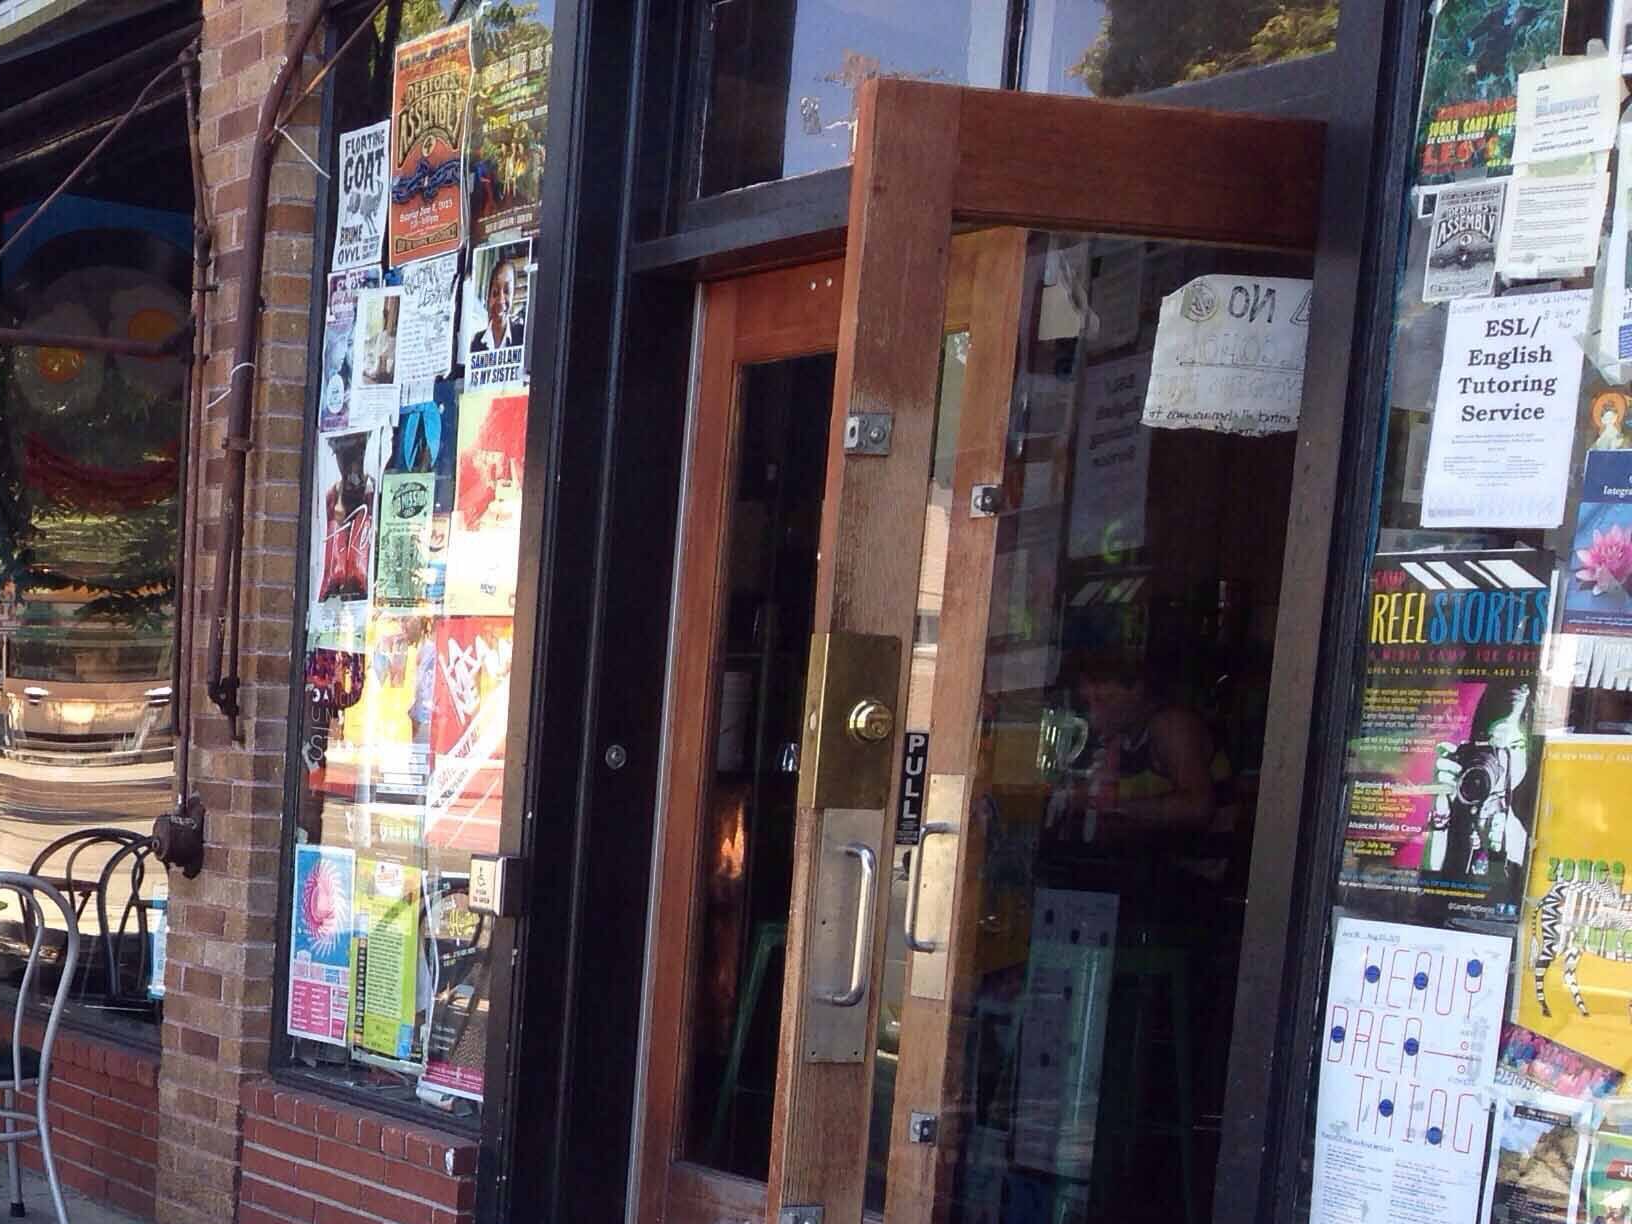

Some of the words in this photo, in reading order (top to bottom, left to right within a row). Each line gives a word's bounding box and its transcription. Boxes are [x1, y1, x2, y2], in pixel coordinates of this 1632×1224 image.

[398, 90, 467, 167] ASSEMBLY
[1463, 114, 1494, 133] CANDY
[345, 129, 385, 158] FLOATING
[343, 148, 385, 194] GOAT
[1436, 213, 1497, 249] ASSEMBLY
[1485, 316, 1541, 338] ESL/
[470, 352, 497, 370] SANDRA
[498, 348, 523, 367] BLAND
[1467, 345, 1553, 370] English
[470, 371, 479, 385] IS
[479, 370, 491, 384] MY
[1457, 375, 1557, 397] Tutoring
[1461, 403, 1545, 422] Service
[1375, 570, 1407, 591] CAMP
[1371, 592, 1428, 645] REEL
[1430, 591, 1550, 645] STORIES
[1391, 667, 1400, 675] TO
[903, 734, 925, 820] PULL
